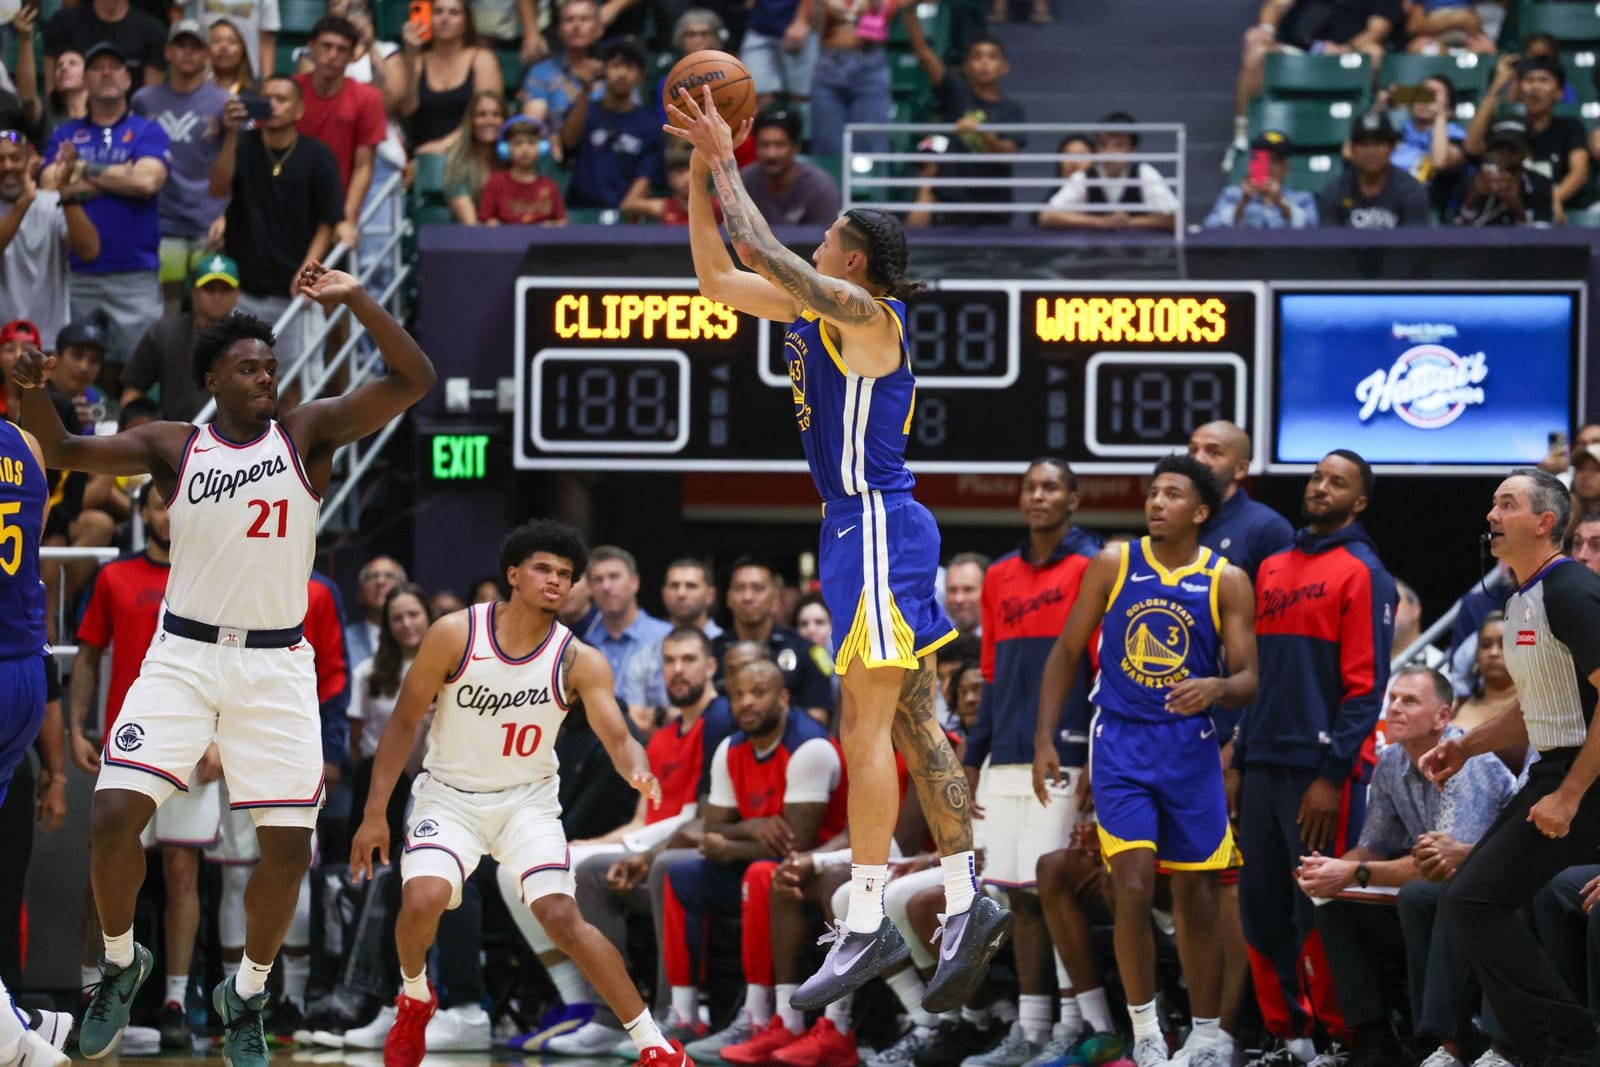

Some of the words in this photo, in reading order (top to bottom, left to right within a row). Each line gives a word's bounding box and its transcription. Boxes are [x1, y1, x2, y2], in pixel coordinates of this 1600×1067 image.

[669, 69, 726, 100] Wilson
[555, 294, 738, 340] CLIPPERS
[1035, 297, 1227, 342] WARRIORS
[432, 434, 489, 480] EXIT
[188, 454, 287, 505] Clippers
[246, 499, 289, 538] 21
[0, 501, 23, 576] 5
[1126, 598, 1168, 618] GOLDEN
[1170, 602, 1195, 627] STATE
[1166, 626, 1180, 646] 3
[1121, 657, 1190, 689] WARRIORS
[456, 684, 552, 716] Clippers
[501, 722, 543, 757] 10
